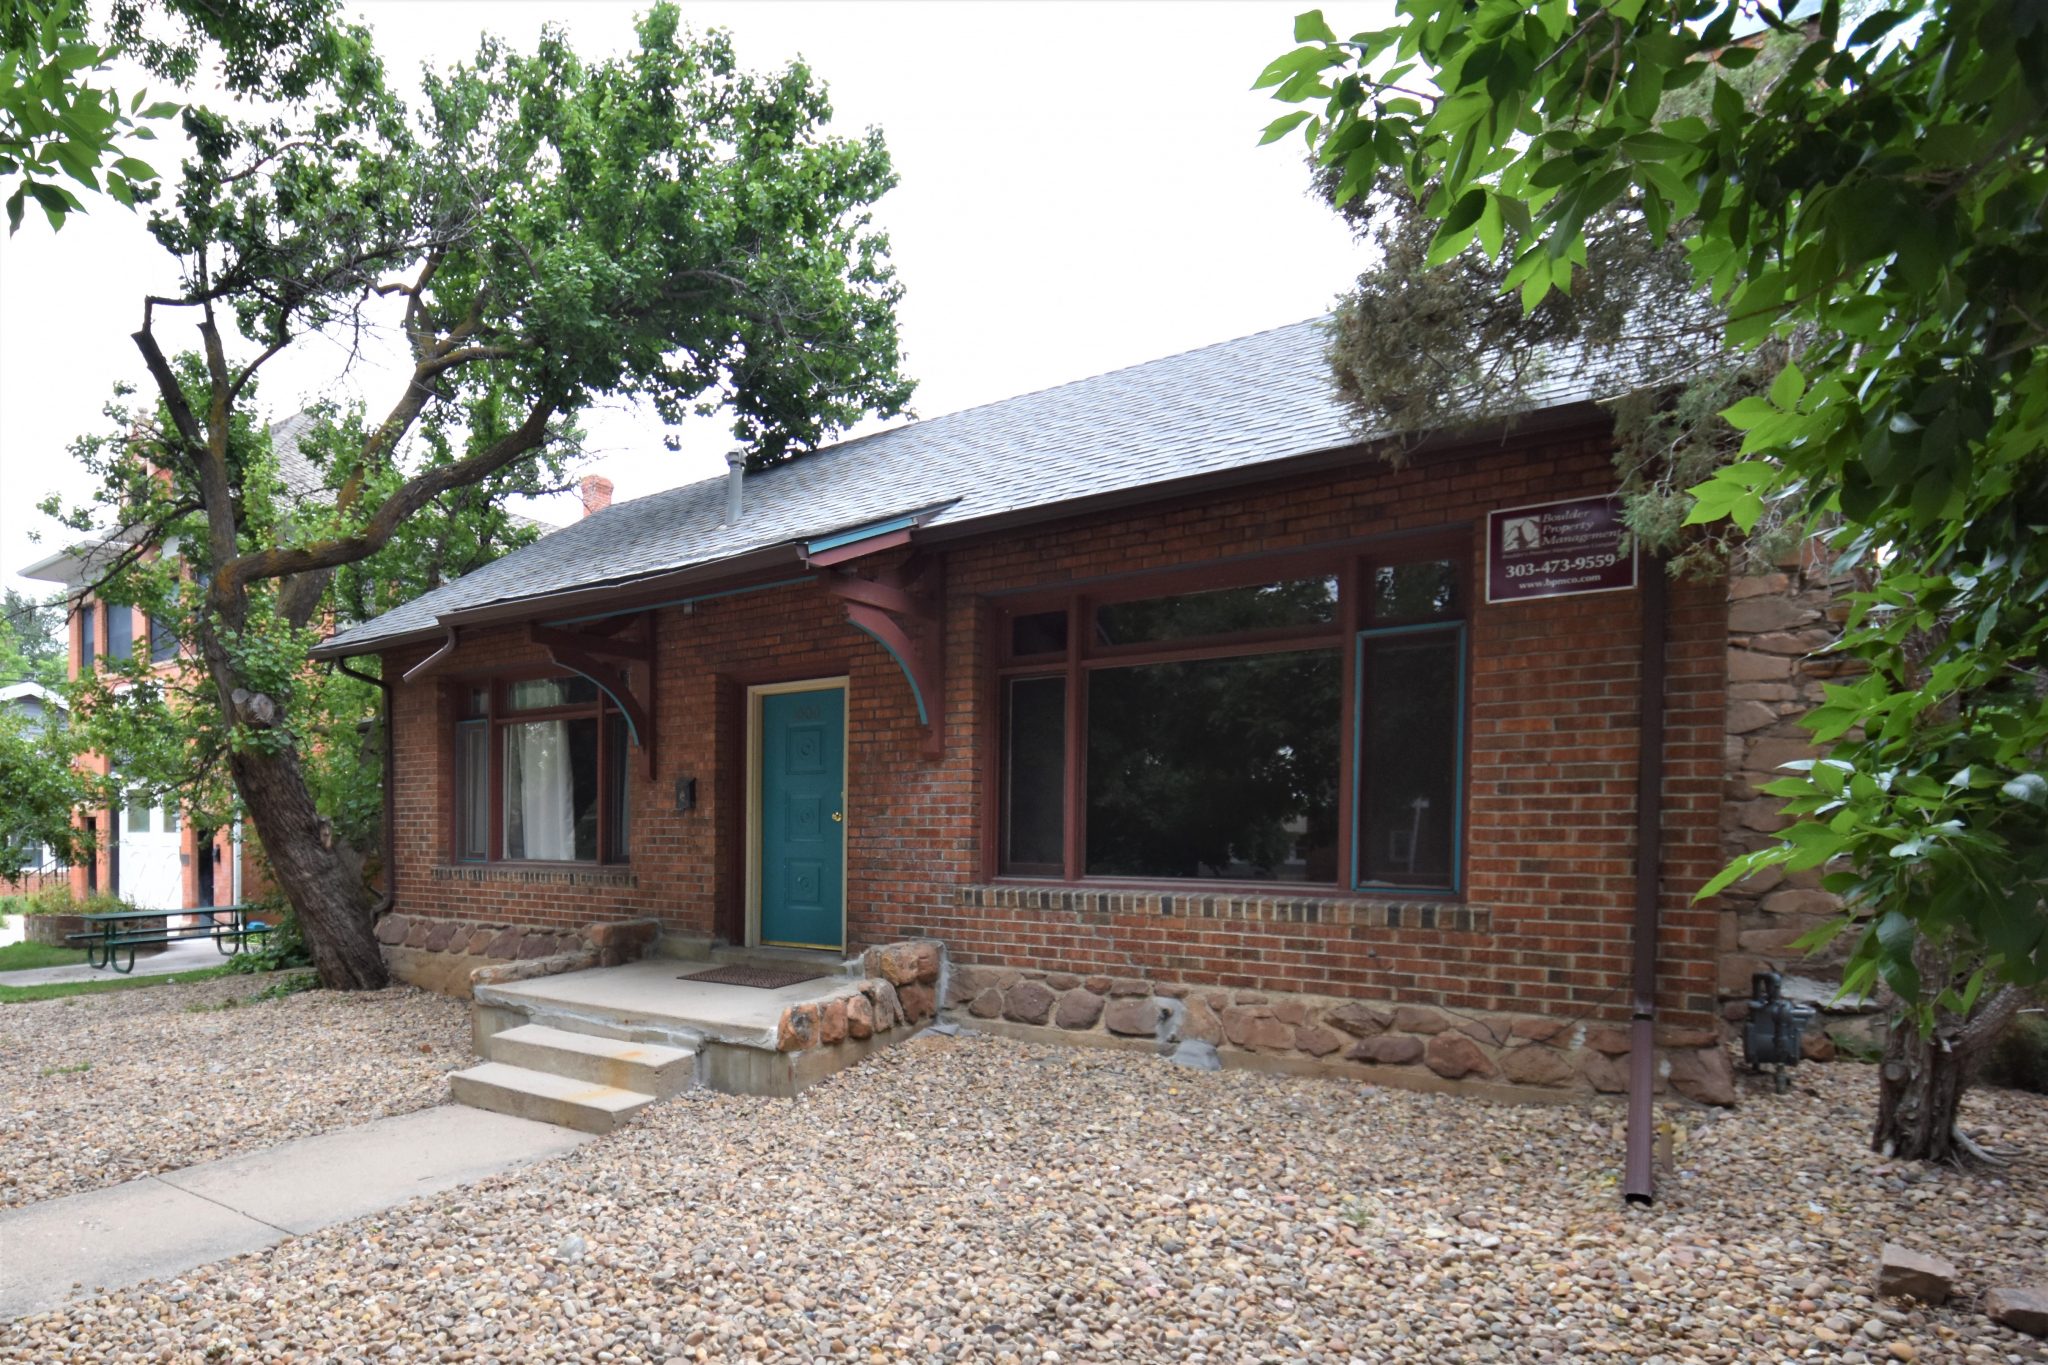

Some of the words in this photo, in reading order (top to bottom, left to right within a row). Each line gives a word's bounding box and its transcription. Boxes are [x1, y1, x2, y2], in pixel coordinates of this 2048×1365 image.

[1542, 509, 1590, 523] Boulder
[1543, 520, 1594, 534] Property
[1541, 529, 1623, 546] Management
[1505, 553, 1616, 578] 303-473-9559
[1519, 574, 1601, 590] www.bpmco.com
